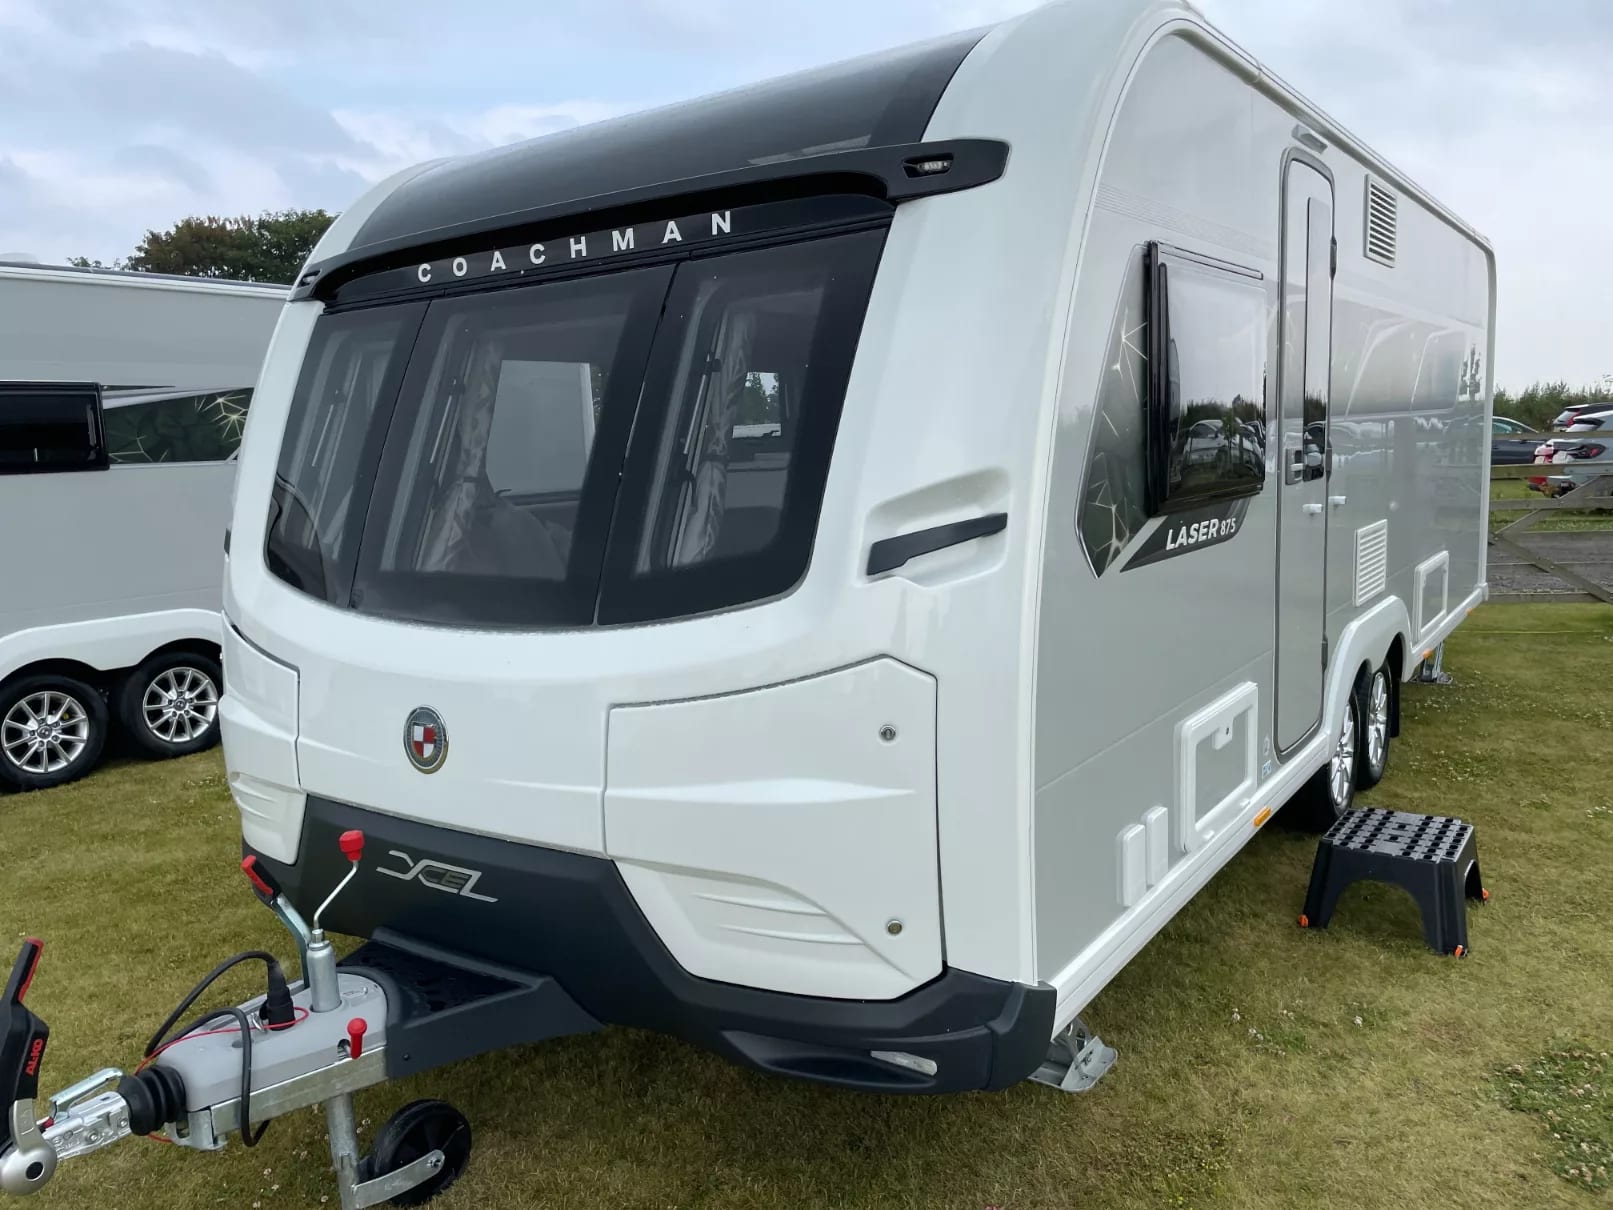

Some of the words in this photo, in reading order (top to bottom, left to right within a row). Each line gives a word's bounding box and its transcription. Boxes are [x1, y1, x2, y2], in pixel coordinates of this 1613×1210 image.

[417, 210, 731, 283] COACHMAN
[1166, 518, 1219, 551] LASER
[1220, 517, 1237, 536] 875
